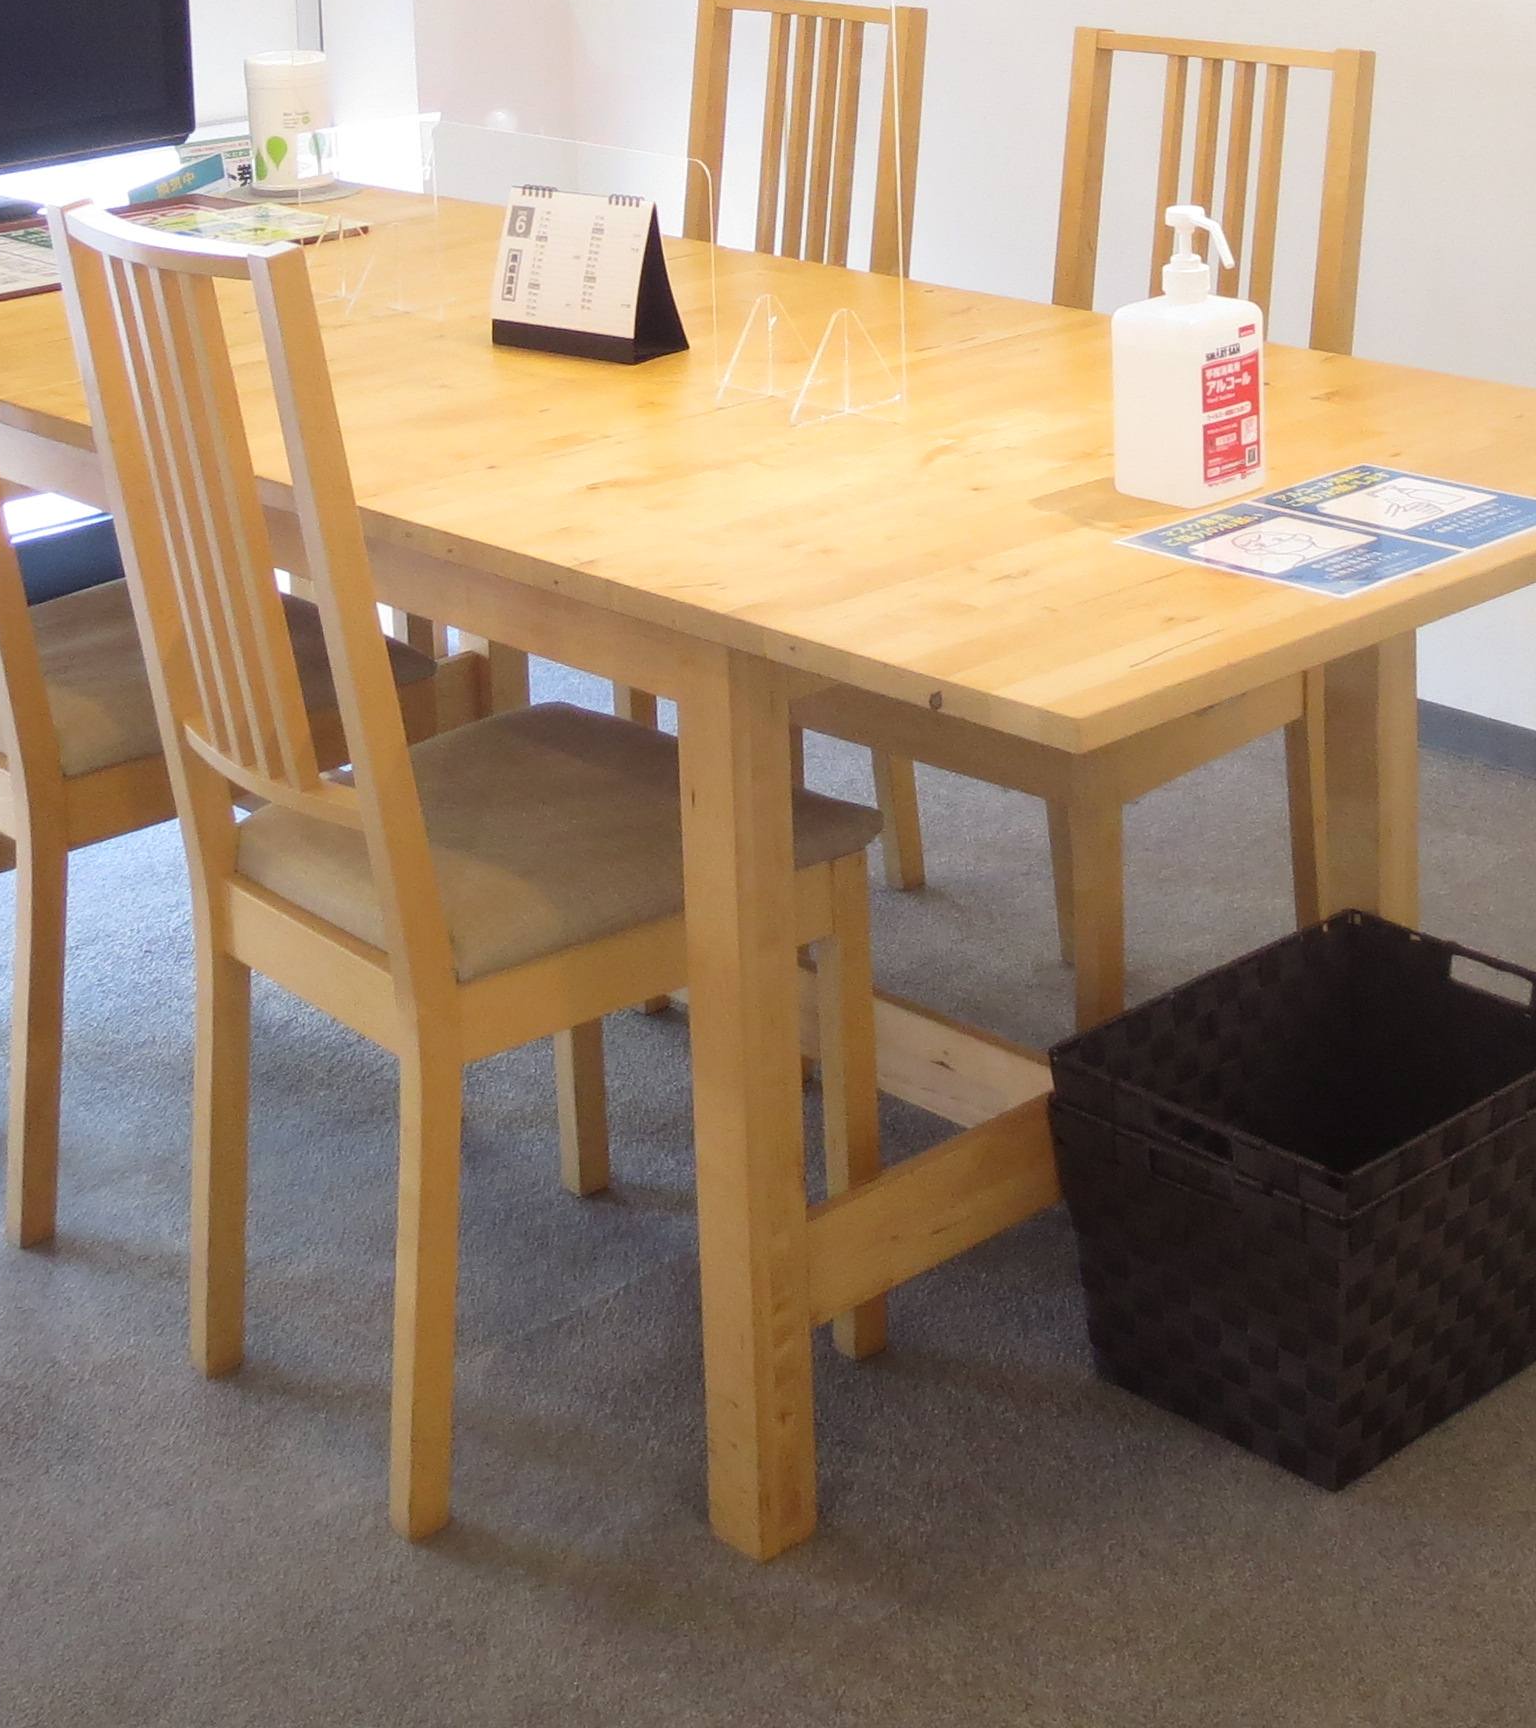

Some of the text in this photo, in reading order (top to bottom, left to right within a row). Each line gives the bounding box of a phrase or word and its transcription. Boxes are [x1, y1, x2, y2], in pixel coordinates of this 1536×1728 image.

[515, 215, 527, 233] 6
[1206, 371, 1251, 396] アルコール
